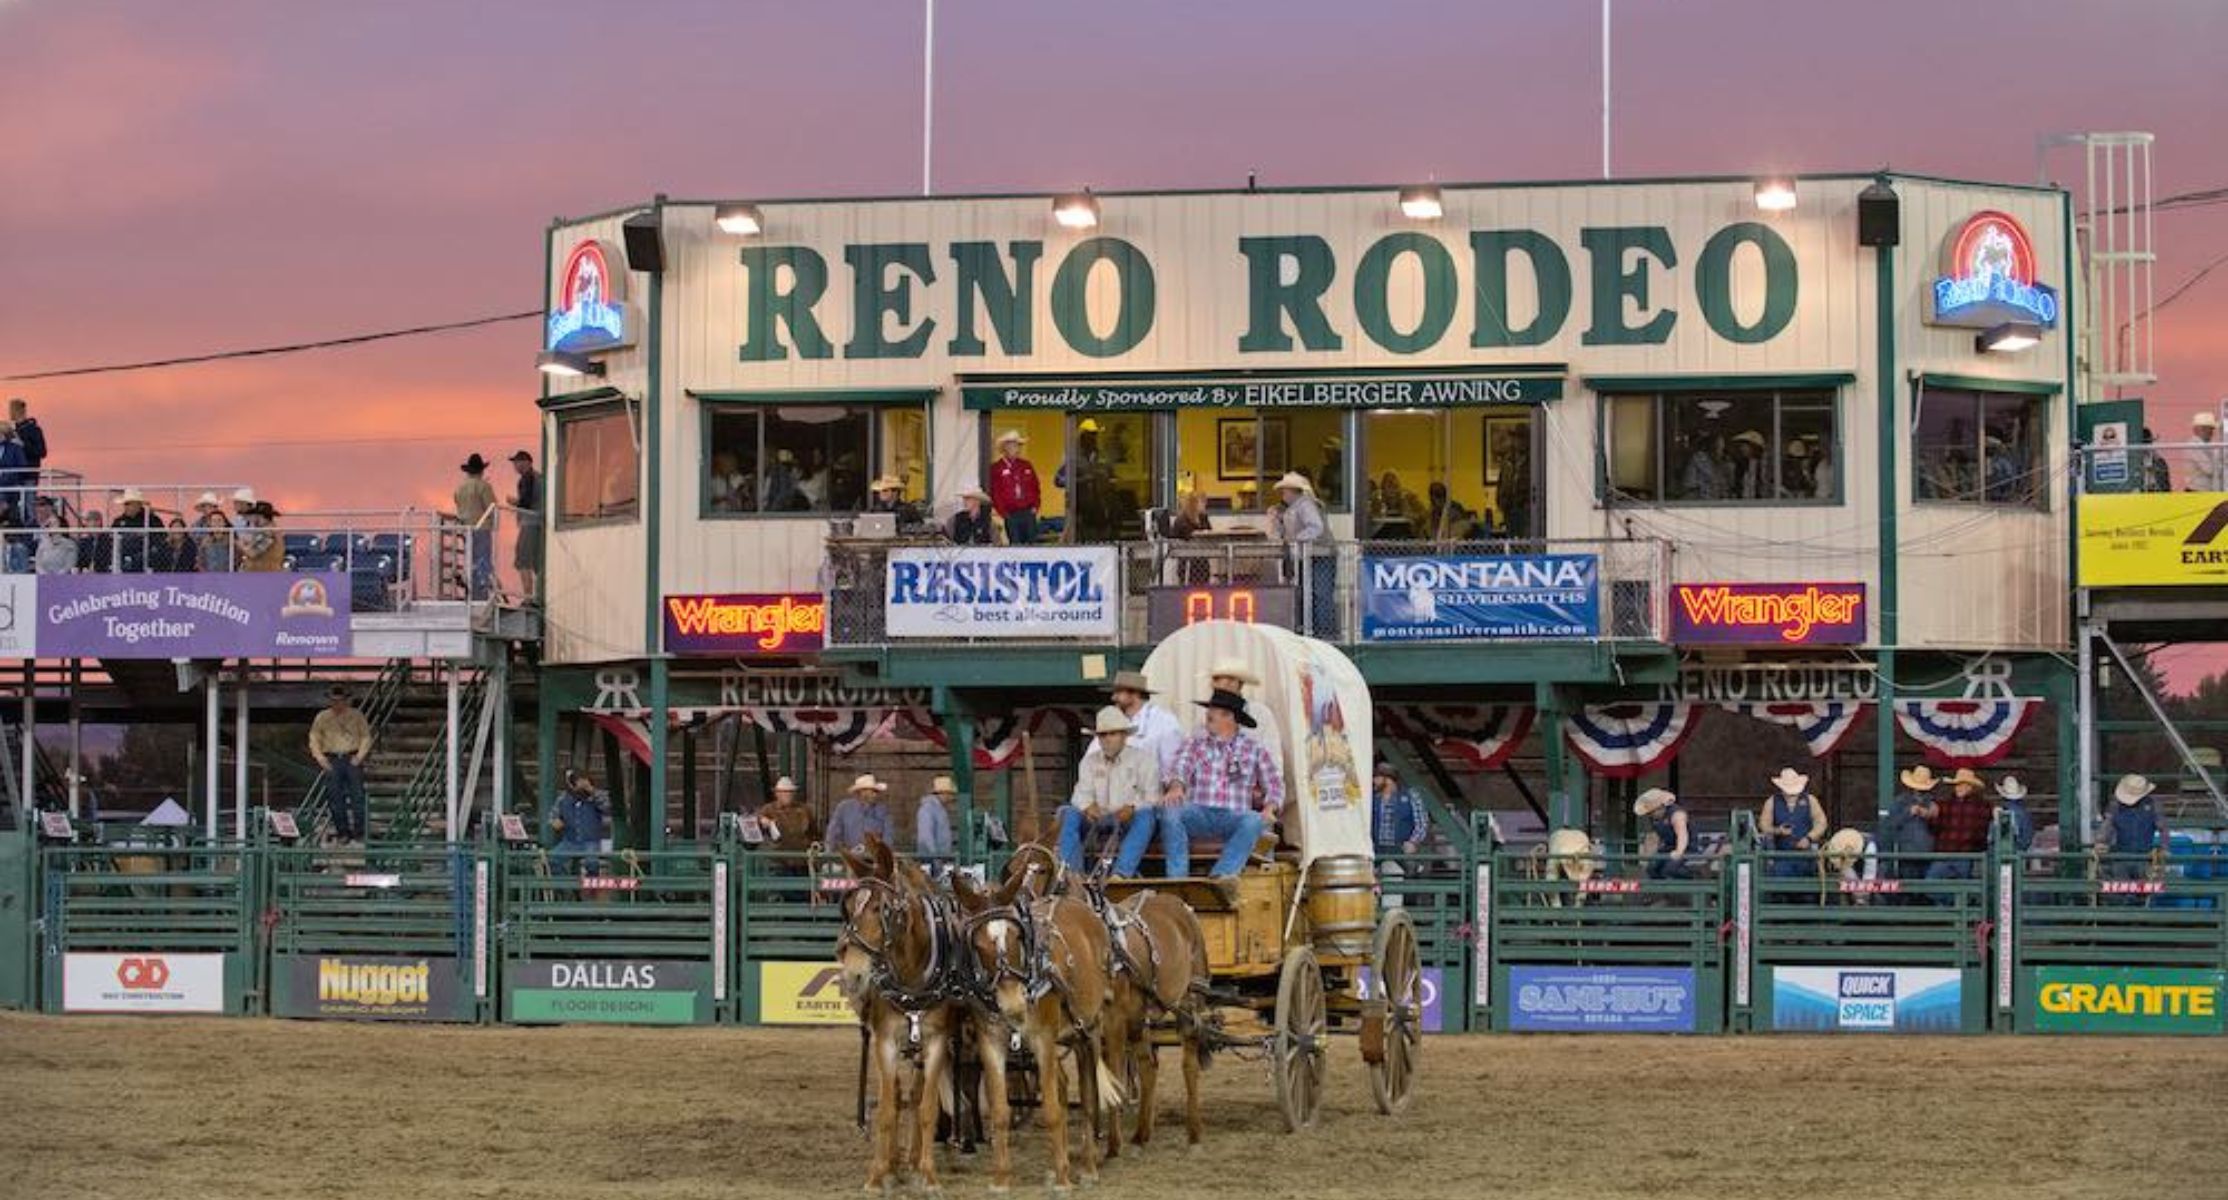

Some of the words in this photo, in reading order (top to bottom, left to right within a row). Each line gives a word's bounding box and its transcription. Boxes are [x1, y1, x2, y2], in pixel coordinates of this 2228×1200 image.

[739, 237, 1156, 361] RENO
[1238, 222, 1799, 354] RODEO
[1005, 388, 1090, 409] Proudly
[1095, 387, 1208, 408] Sponsored
[1211, 386, 1240, 406] By
[1244, 382, 1410, 406] EIKELBERGER
[1420, 379, 1521, 402] AWNING
[891, 560, 1103, 604] RESISTOL
[1373, 560, 1585, 589] MONTANA
[48, 588, 161, 625] Celebrating
[166, 586, 251, 625] Tradition
[1436, 591, 1588, 606] SILVERSMITHS
[668, 597, 825, 650] Wrangler
[973, 608, 1010, 622] best
[1015, 607, 1103, 622] all-around
[1679, 587, 1861, 642] Wrangler
[102, 616, 196, 643] Together
[275, 631, 340, 646] Renown
[1372, 622, 1588, 637] montanasilversmiths.com
[1760, 667, 1878, 700] RODEO
[319, 958, 430, 1005] Nugget
[551, 963, 656, 990] DALLAS
[1842, 975, 1891, 996] QUICK
[1842, 1003, 1890, 1021] SPACE
[2040, 982, 2215, 1016] GRANITE
